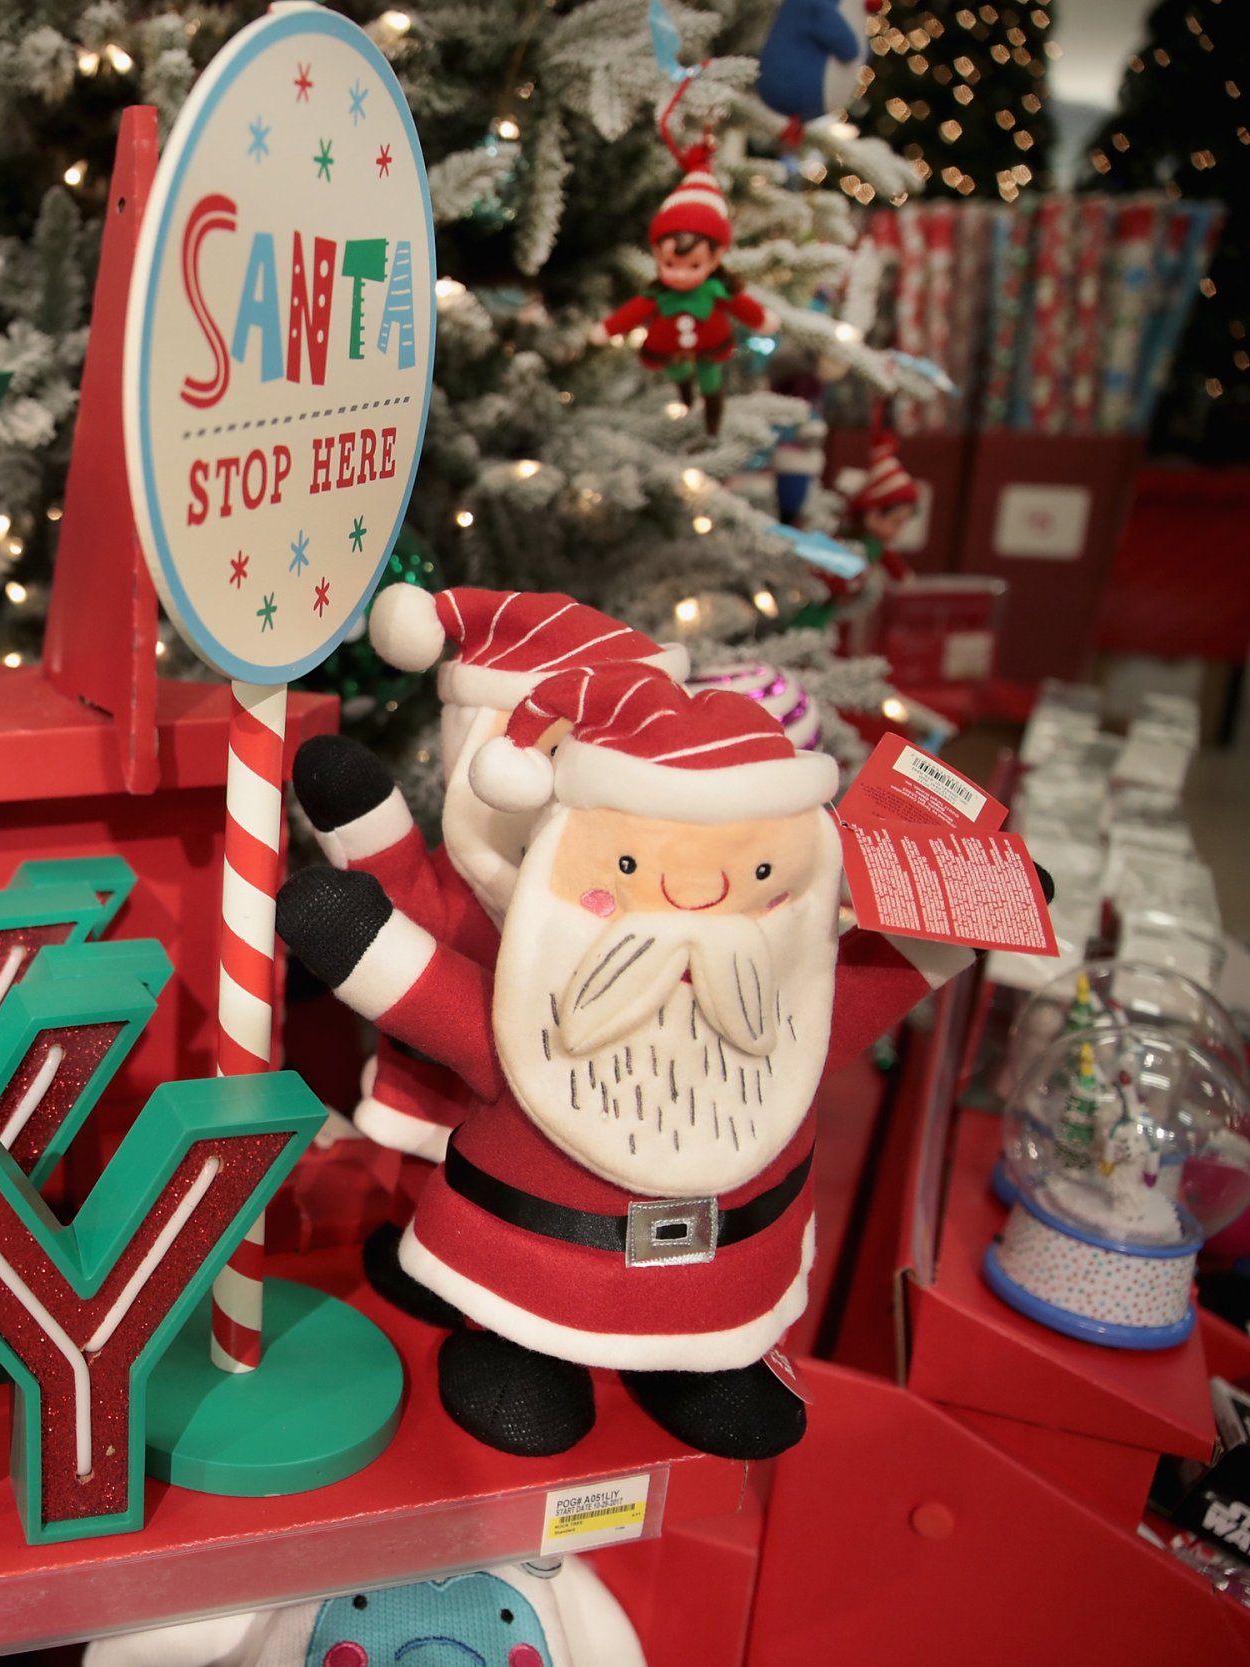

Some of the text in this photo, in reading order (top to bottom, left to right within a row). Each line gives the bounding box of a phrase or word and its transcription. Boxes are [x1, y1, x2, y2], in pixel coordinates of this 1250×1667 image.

[180, 193, 415, 408] SANTA
[187, 426, 396, 527] STOP HERE
[556, 1506, 575, 1516] START
[576, 1504, 592, 1513] DATE
[557, 1498, 582, 1509] POG#
